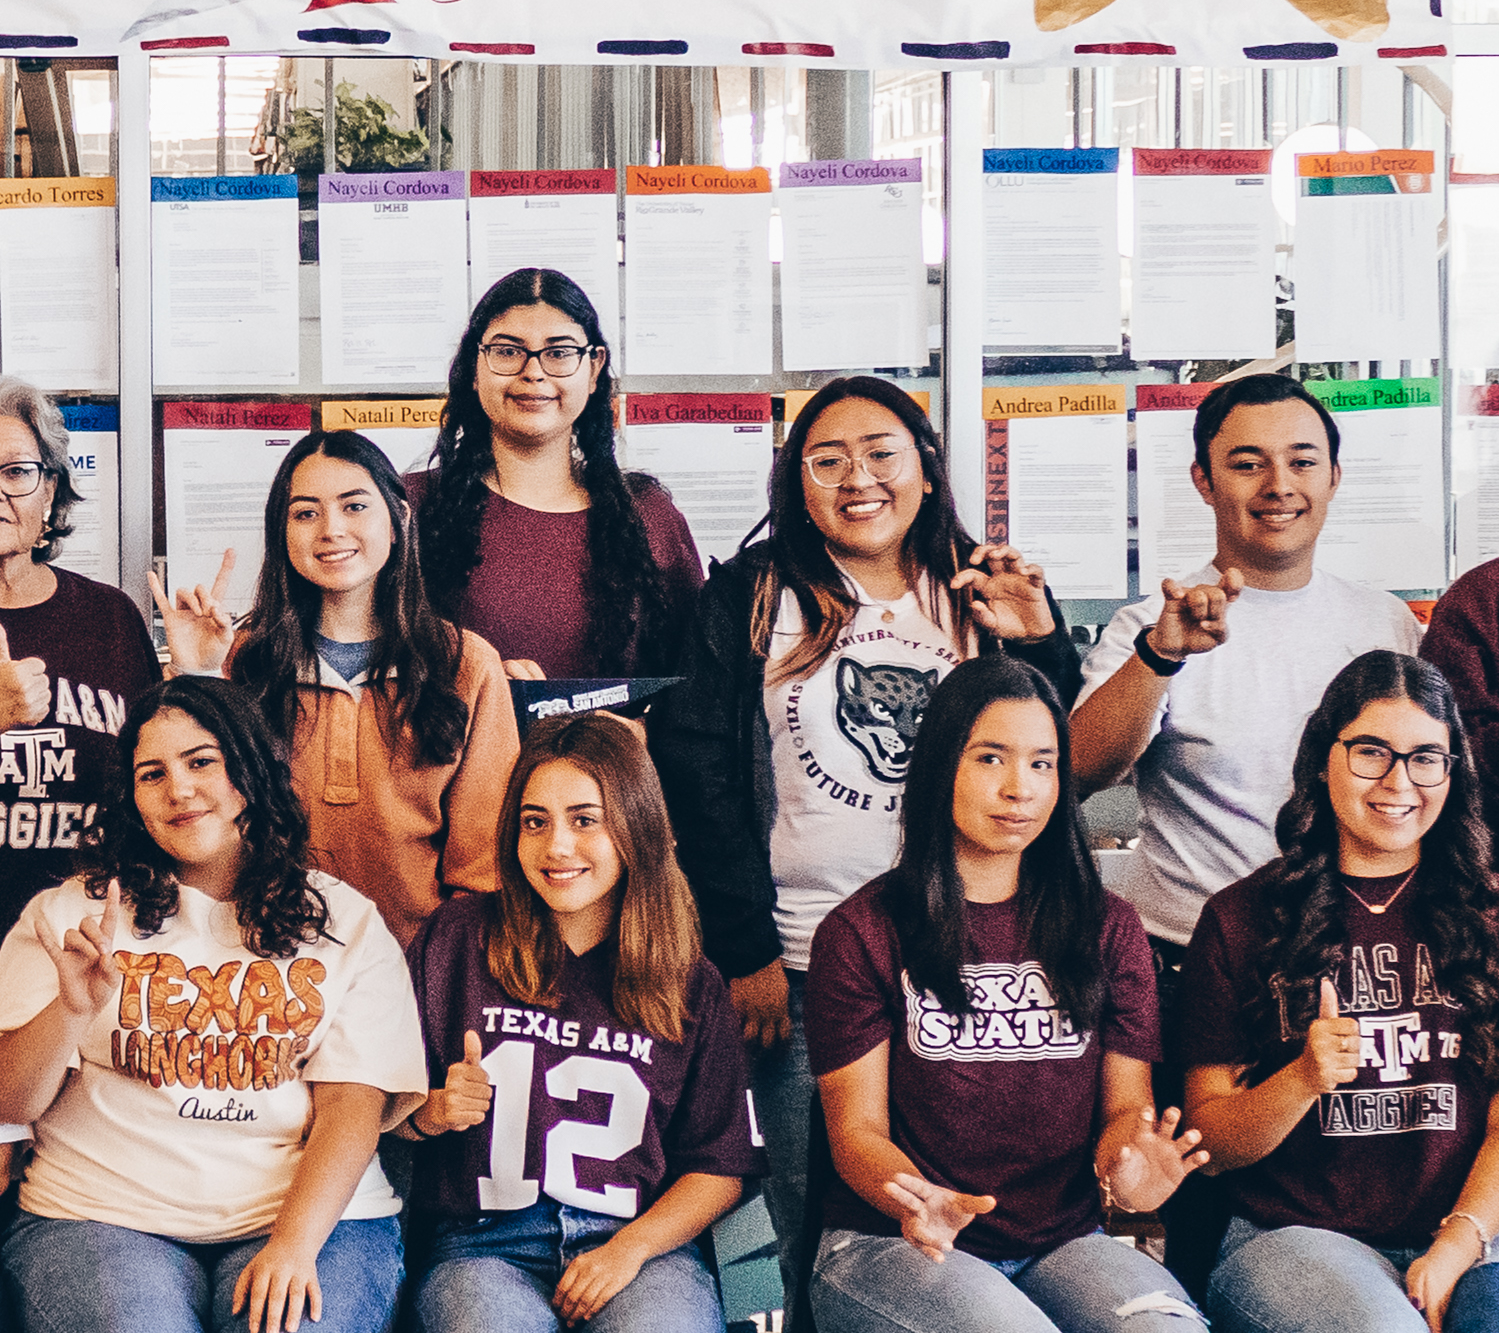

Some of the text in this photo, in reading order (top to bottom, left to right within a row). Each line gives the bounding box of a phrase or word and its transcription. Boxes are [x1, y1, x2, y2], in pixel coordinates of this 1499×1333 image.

[787, 163, 908, 183] Nayeli Cordova
[1038, 155, 1105, 171] Cordova
[1313, 155, 1417, 174] Mario Perez
[215, 181, 282, 196] Cordova
[327, 180, 450, 198] Nayeli Cordova
[480, 172, 601, 192] Nayeli Cordova
[635, 172, 758, 190] Nayeli Cordova
[48, 185, 105, 203] Torres
[373, 203, 409, 213] UMHB
[990, 394, 1117, 414] Andrea Padilla
[1372, 387, 1432, 406] Padilla
[242, 408, 290, 426] Perez
[342, 404, 439, 424] Natali Pere
[632, 403, 764, 421] Iva Garabedian
[786, 683, 804, 734] TEXAS
[798, 749, 874, 811] FUTURE
[111, 949, 328, 1038] TEXAS
[481, 1005, 654, 1066] TEXAS A&M
[178, 1095, 259, 1122] Austin
[1325, 1087, 1456, 1133] AGGIES
[477, 1039, 651, 1219] 12
